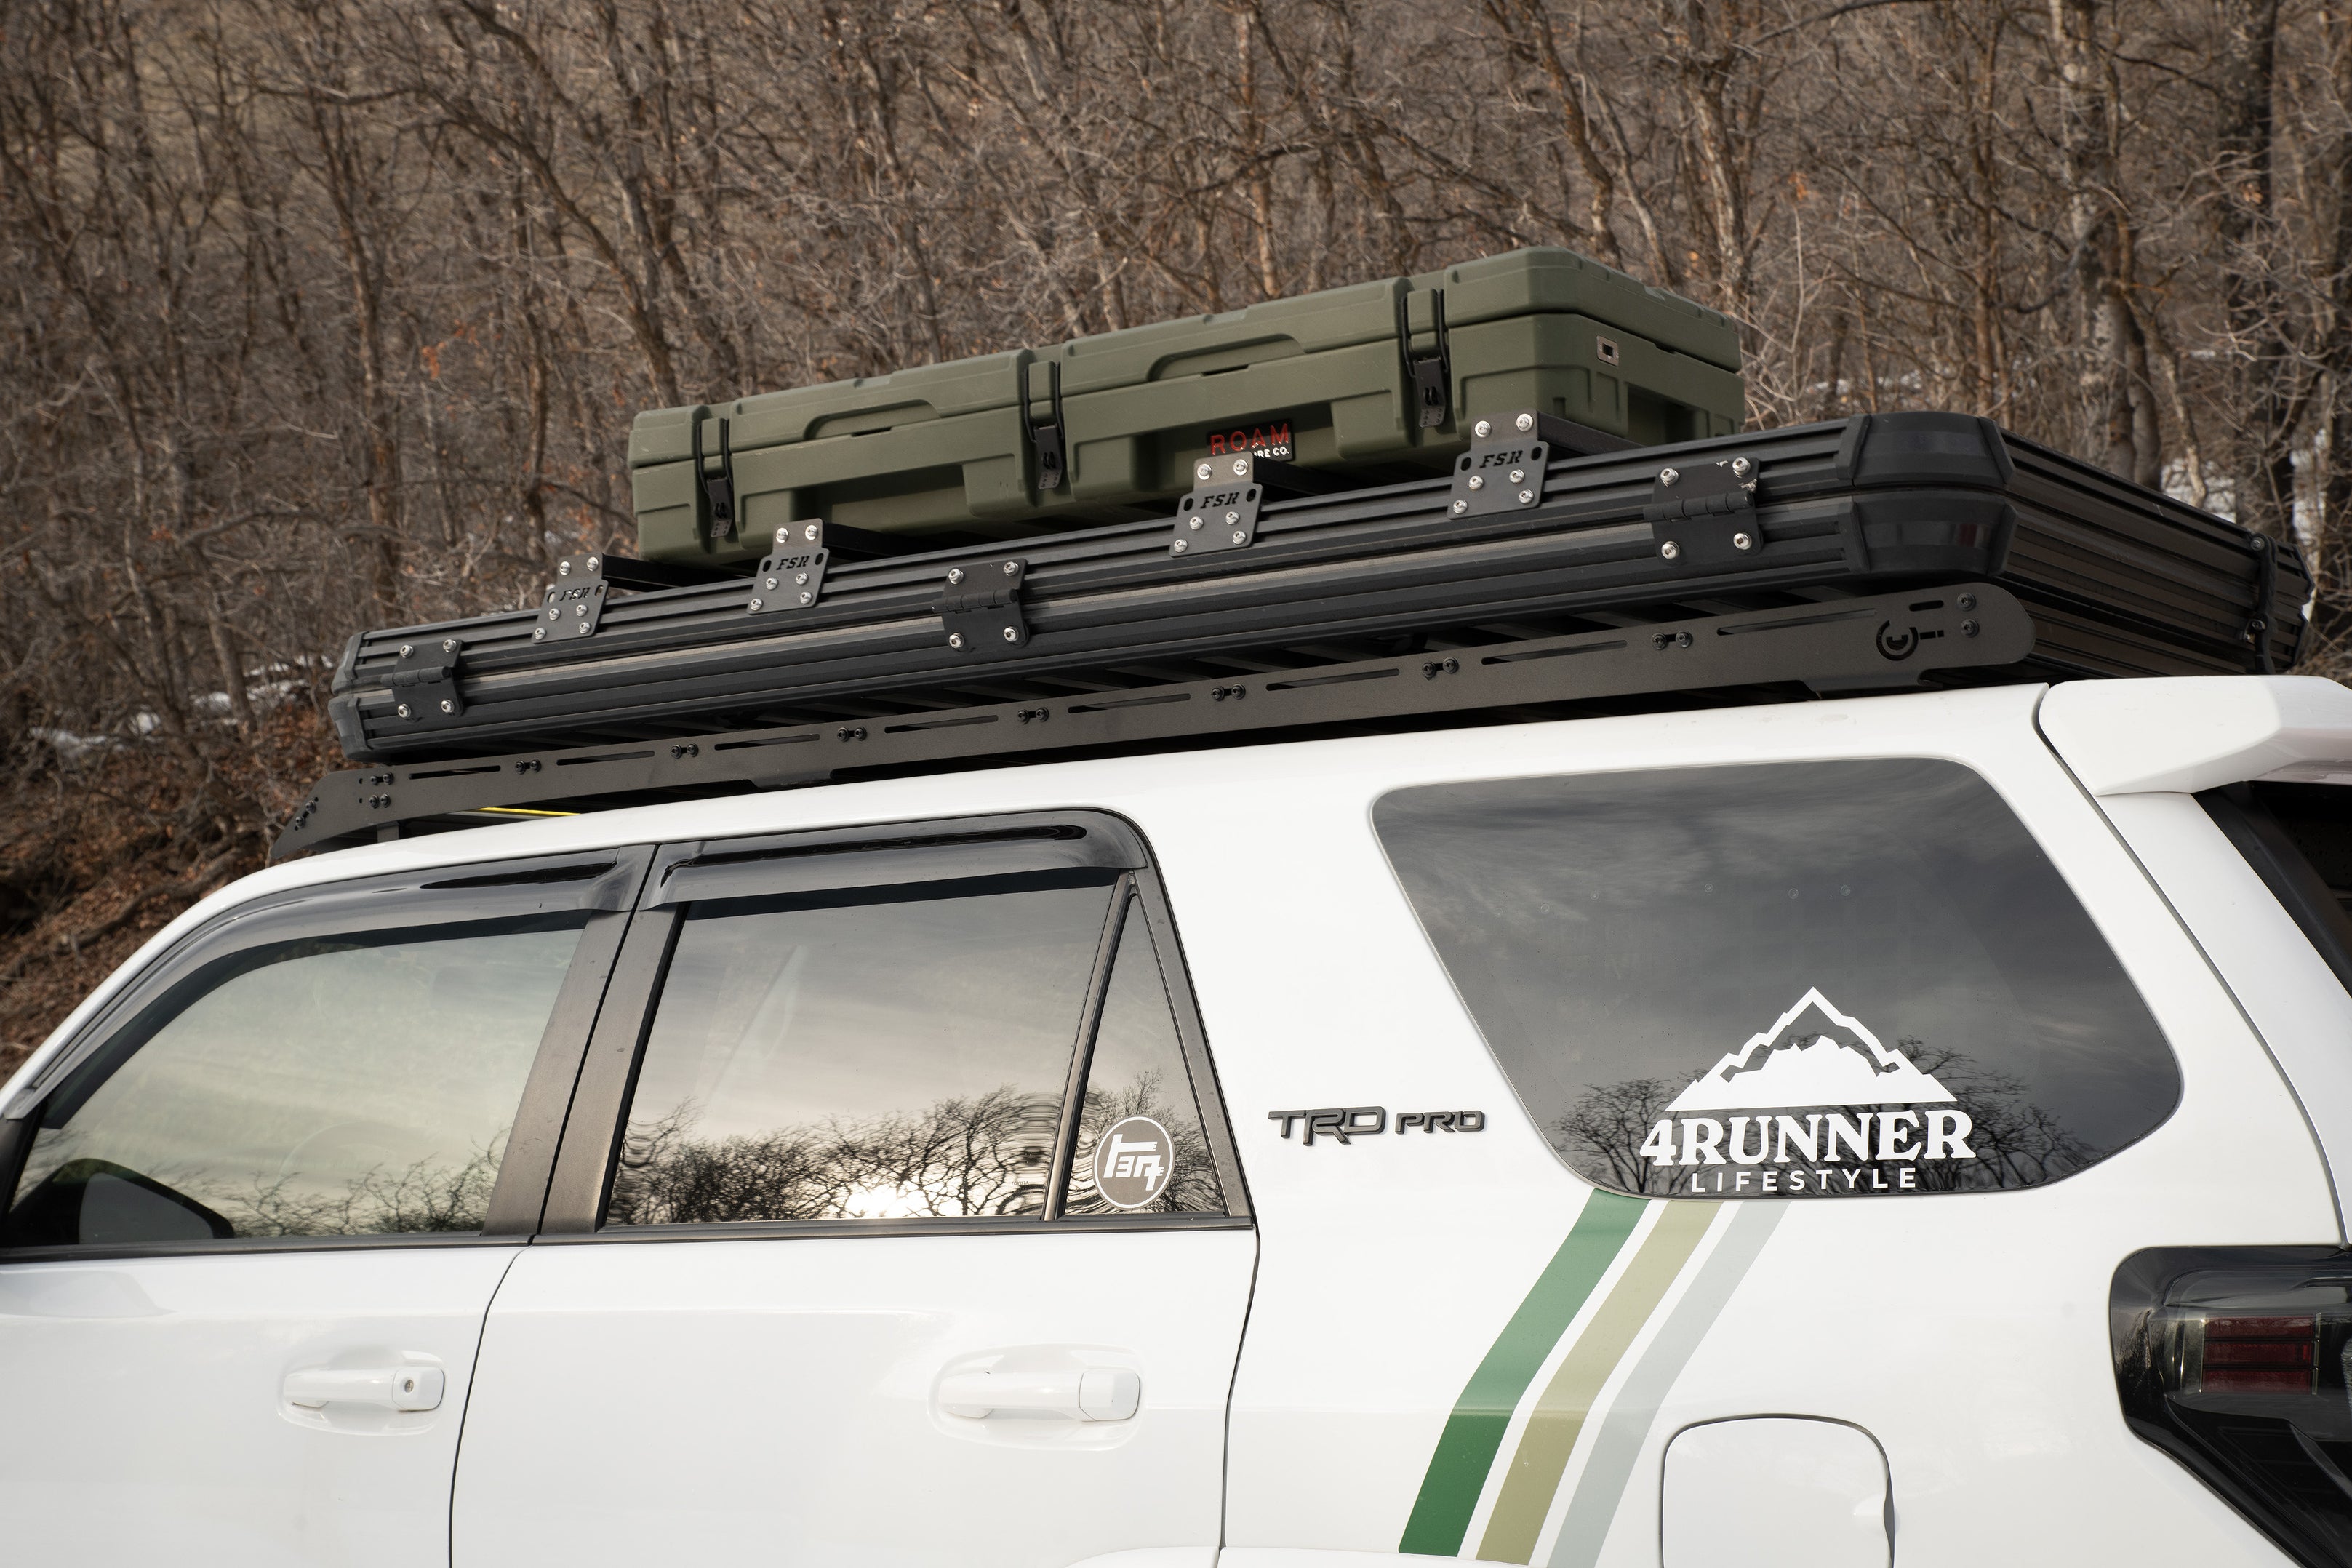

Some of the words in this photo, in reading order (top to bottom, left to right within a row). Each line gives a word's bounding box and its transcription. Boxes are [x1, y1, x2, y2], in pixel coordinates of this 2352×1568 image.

[1210, 423, 1289, 455] ROAM
[1479, 450, 1523, 468] FSR
[1200, 492, 1240, 508] FSR
[777, 555, 809, 570] FSR
[559, 586, 591, 601] FSR
[1268, 1105, 1386, 1147] TRD
[1394, 1110, 1485, 1135] PRO
[1639, 1109, 1977, 1167] 4RUNNER
[1692, 1167, 1917, 1193] LIFESTYLE
